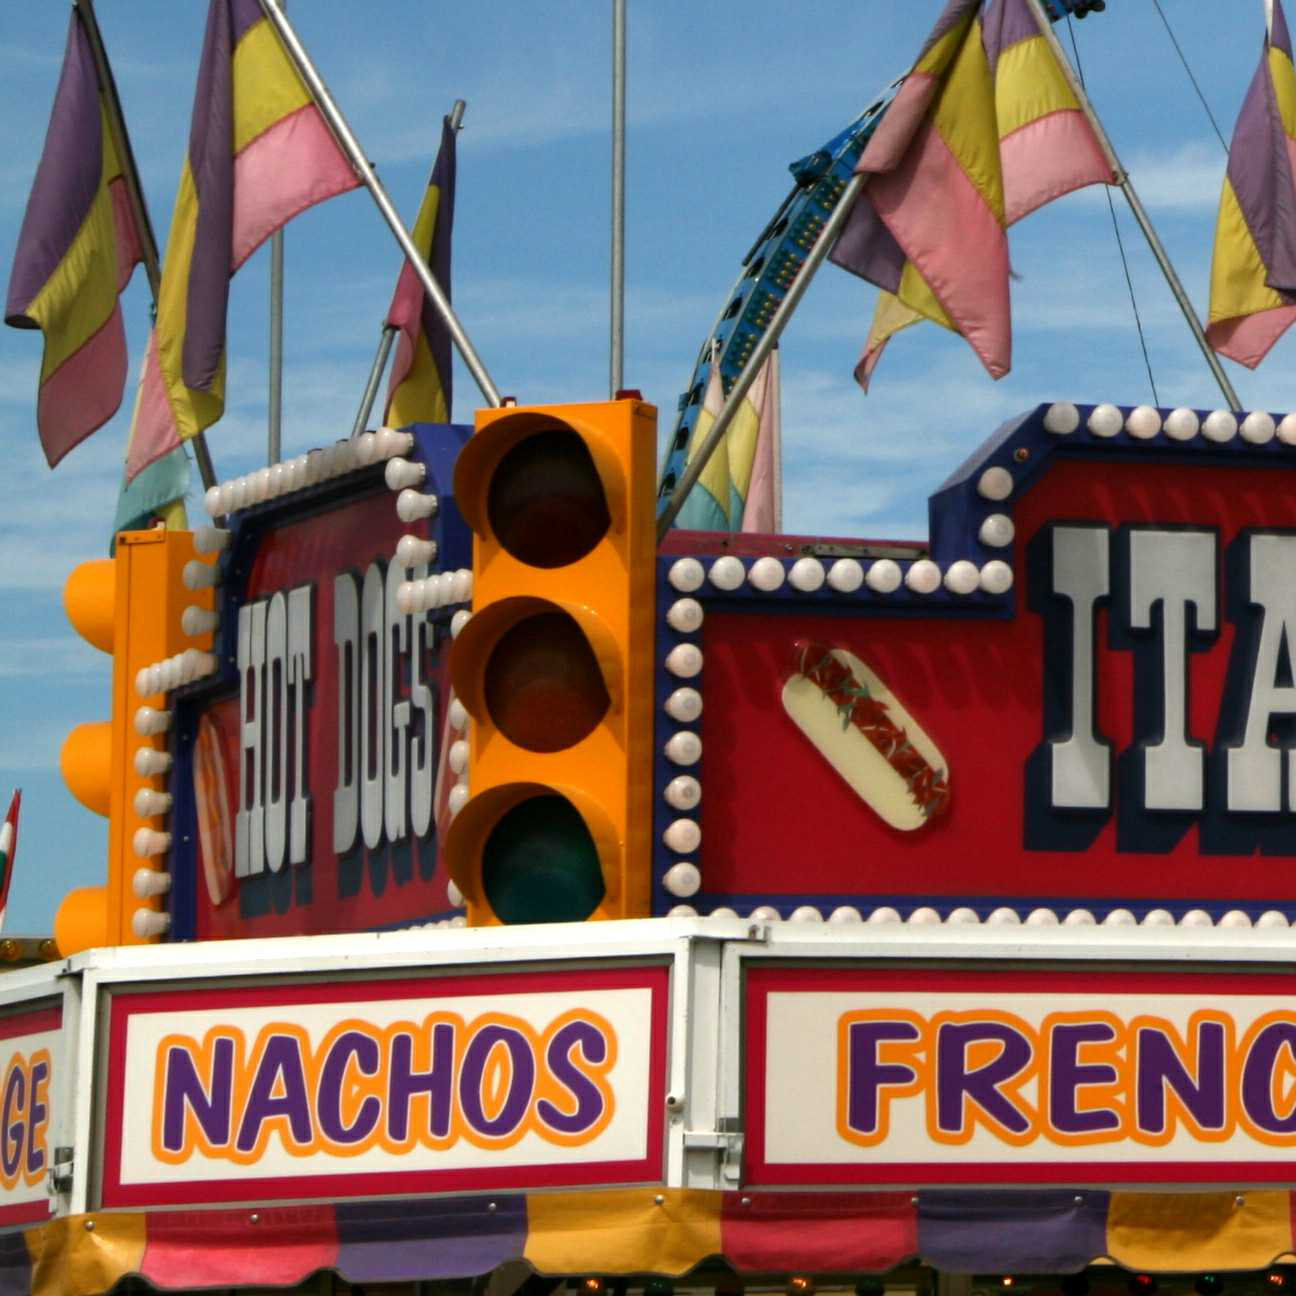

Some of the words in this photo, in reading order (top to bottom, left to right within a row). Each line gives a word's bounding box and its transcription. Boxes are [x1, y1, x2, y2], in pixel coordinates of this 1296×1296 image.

[235, 585, 311, 879] HOT
[333, 552, 434, 854] DOGS
[151, 1008, 617, 1165] NACHOS
